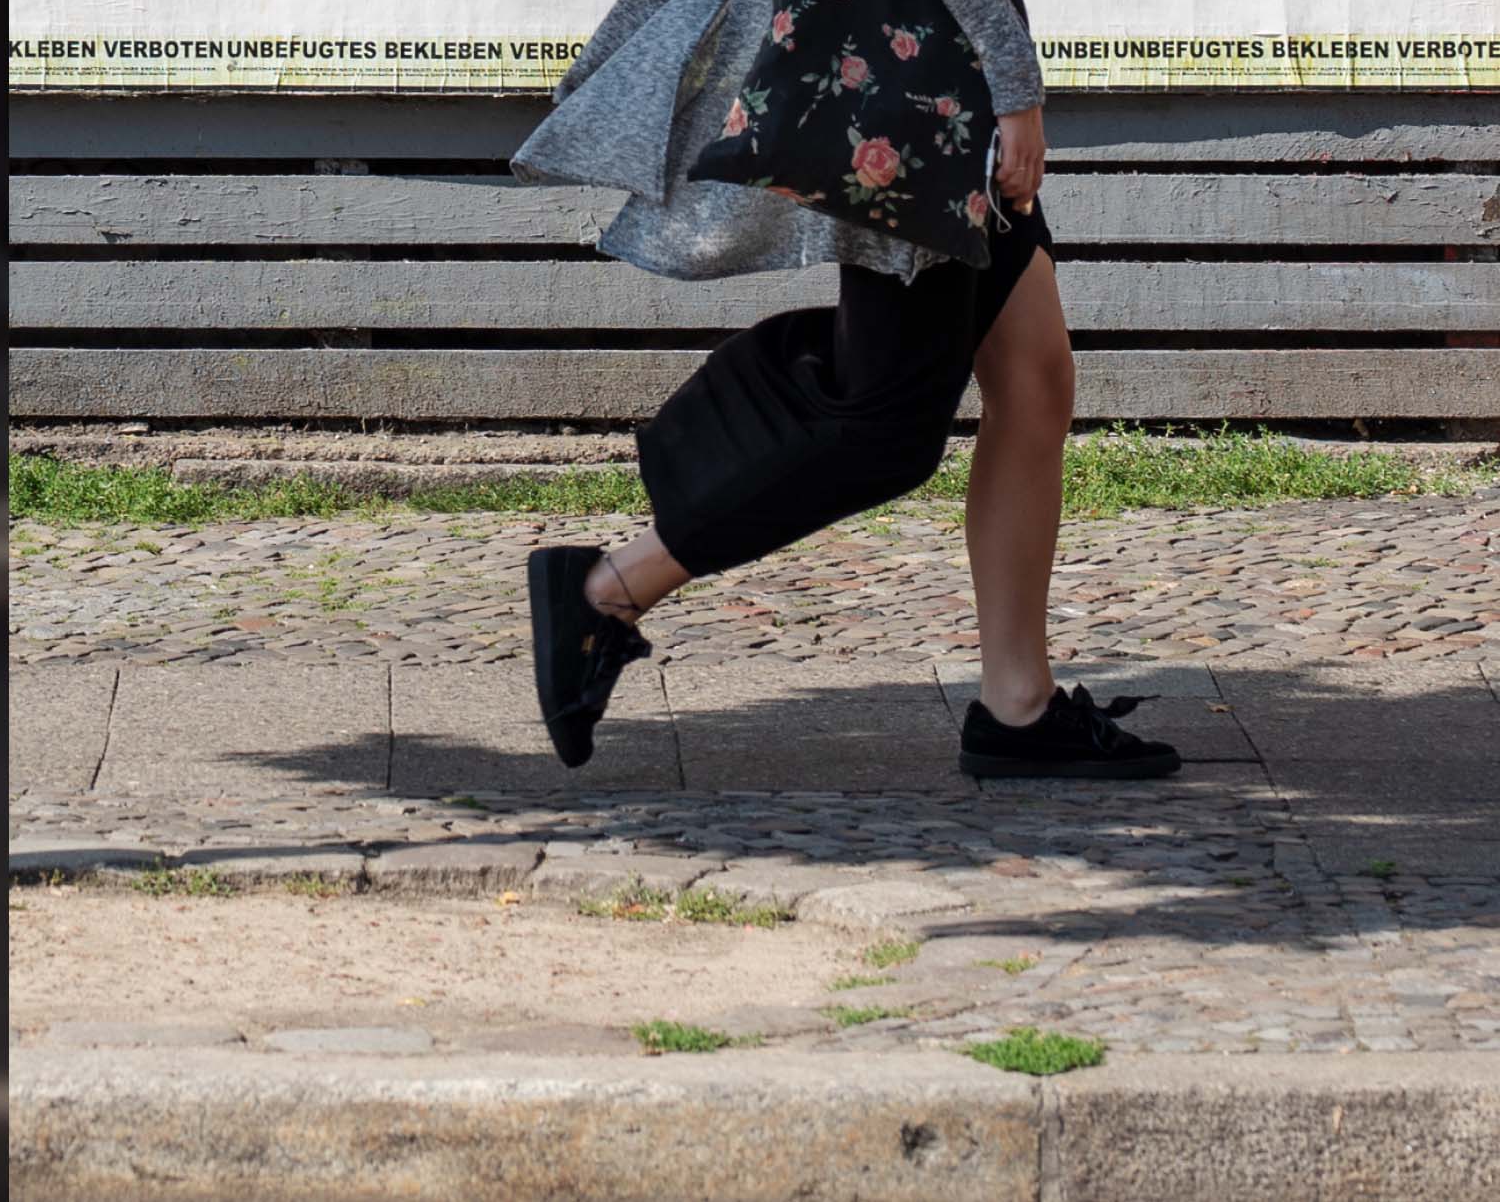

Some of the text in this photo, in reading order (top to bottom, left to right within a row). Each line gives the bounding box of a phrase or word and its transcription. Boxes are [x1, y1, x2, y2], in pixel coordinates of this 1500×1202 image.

[8, 41, 223, 58] KLEBEN VERBOTEN
[227, 41, 377, 59] UNBEFUGTES
[385, 41, 503, 59] BEKLEBEN
[1114, 41, 1264, 58] UNBEFUGTES
[1272, 41, 1389, 58] BEKLEBEN
